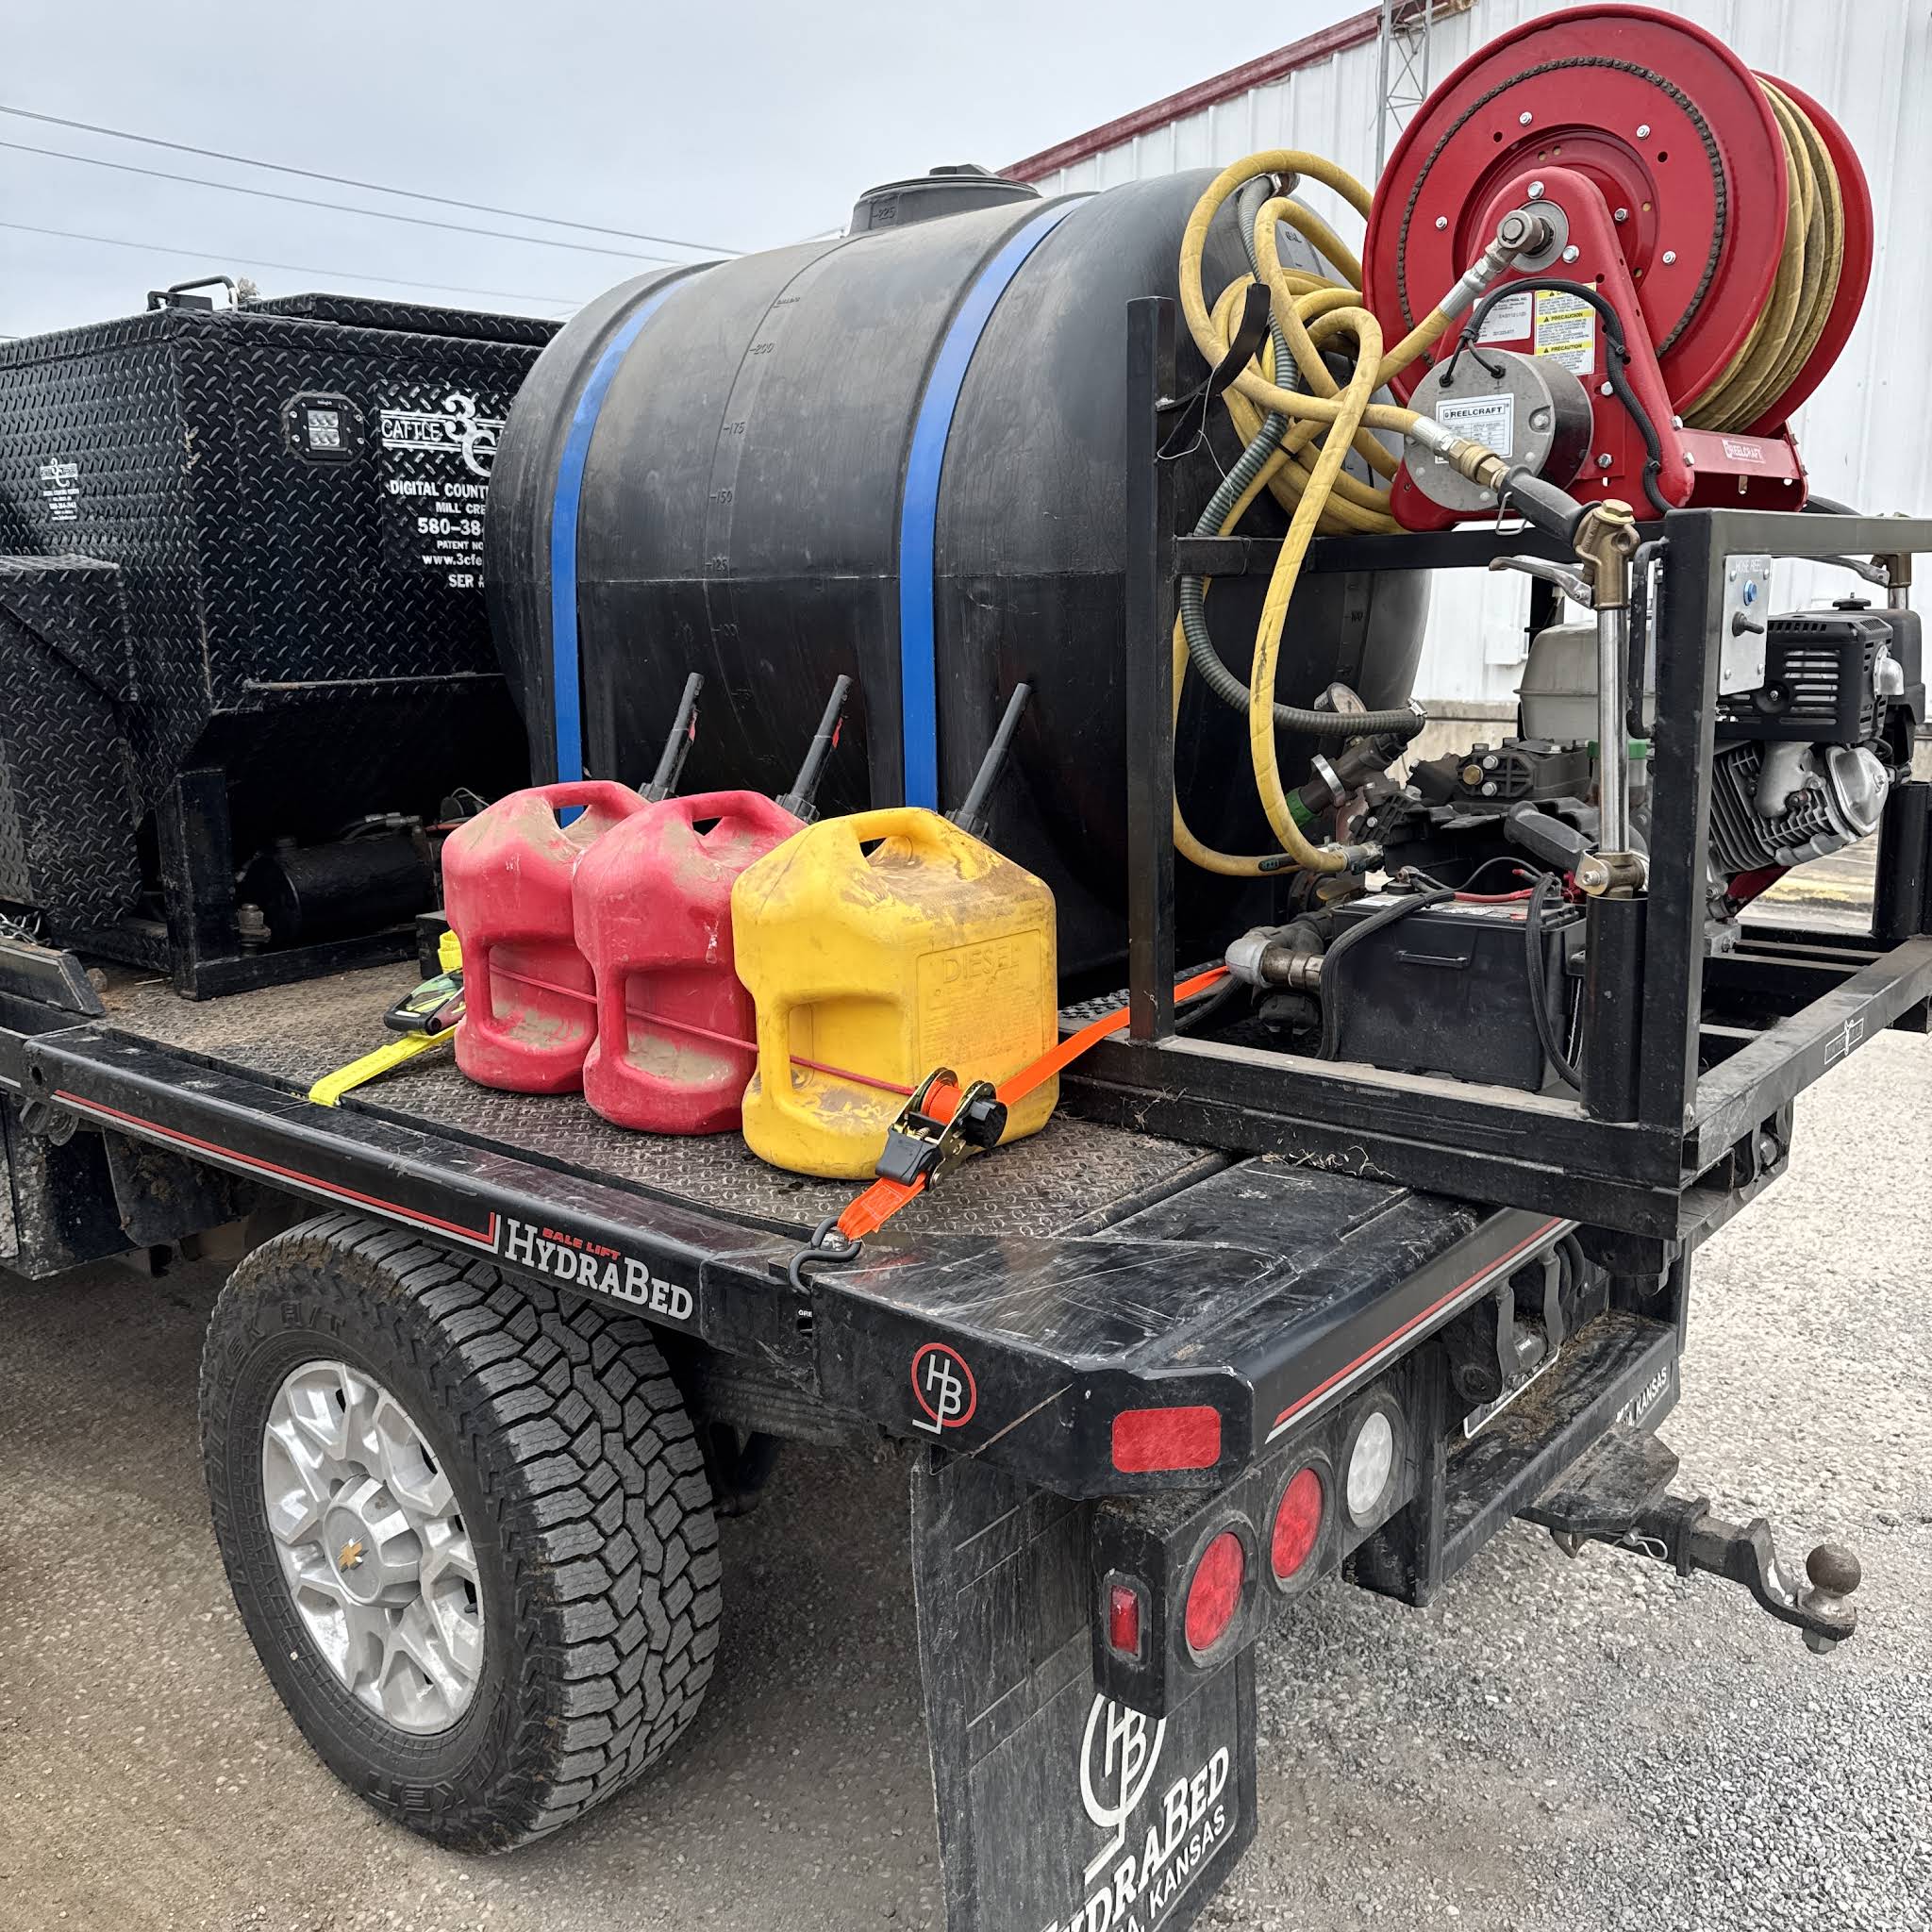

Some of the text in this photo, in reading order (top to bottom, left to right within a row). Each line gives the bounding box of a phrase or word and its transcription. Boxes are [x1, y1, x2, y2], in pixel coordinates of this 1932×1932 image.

[753, 342, 774, 356] 200
[1450, 406, 1503, 418] REELCRAFT
[381, 419, 441, 442] CATTLE
[729, 422, 745, 435] 175
[390, 479, 440, 496] DIGITAL
[717, 491, 733, 504] 150
[435, 501, 461, 514] MILL
[417, 517, 485, 536] 580-38
[437, 540, 470, 550] PATENT
[448, 574, 474, 589] SER
[941, 944, 1021, 985] DIESEL
[541, 1226, 622, 1261] BALE LIFT
[1636, 1366, 1667, 1421] KANSAS
[1041, 1746, 1228, 1932] DRABED
[1149, 1804, 1226, 1920] KANSAS
